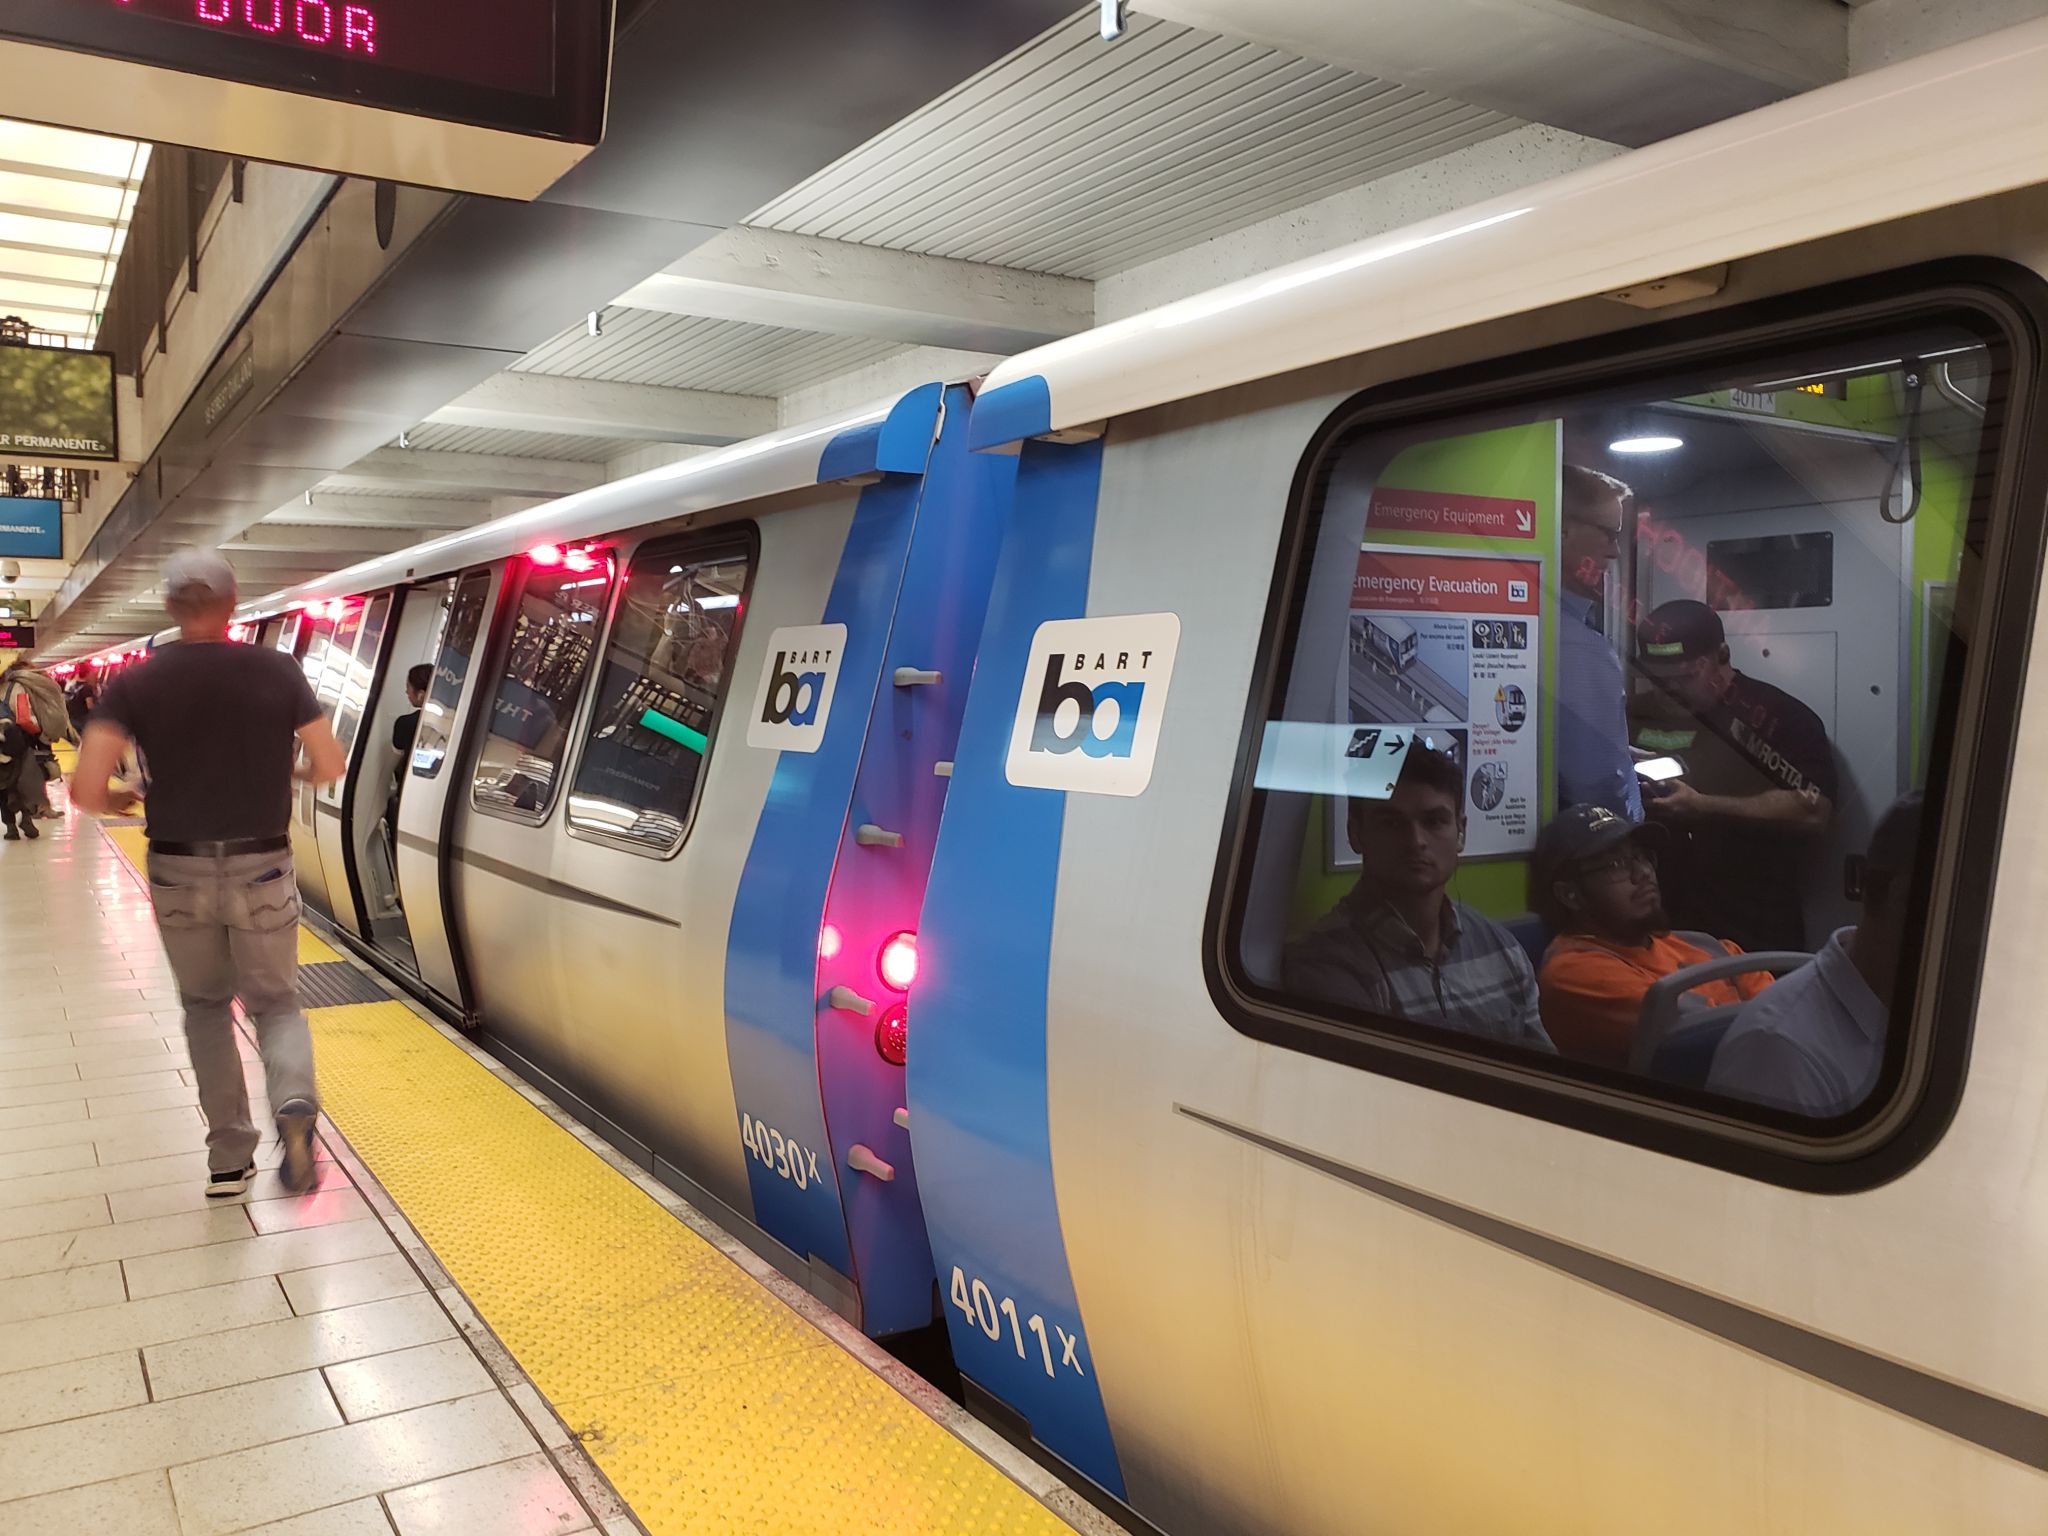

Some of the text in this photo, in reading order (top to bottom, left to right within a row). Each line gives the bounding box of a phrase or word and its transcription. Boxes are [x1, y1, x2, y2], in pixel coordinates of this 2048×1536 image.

[1374, 502, 1505, 526] Emergency Equipment
[1429, 575, 1498, 595] Evacuation
[789, 649, 833, 665] BART
[1074, 650, 1154, 671] BART
